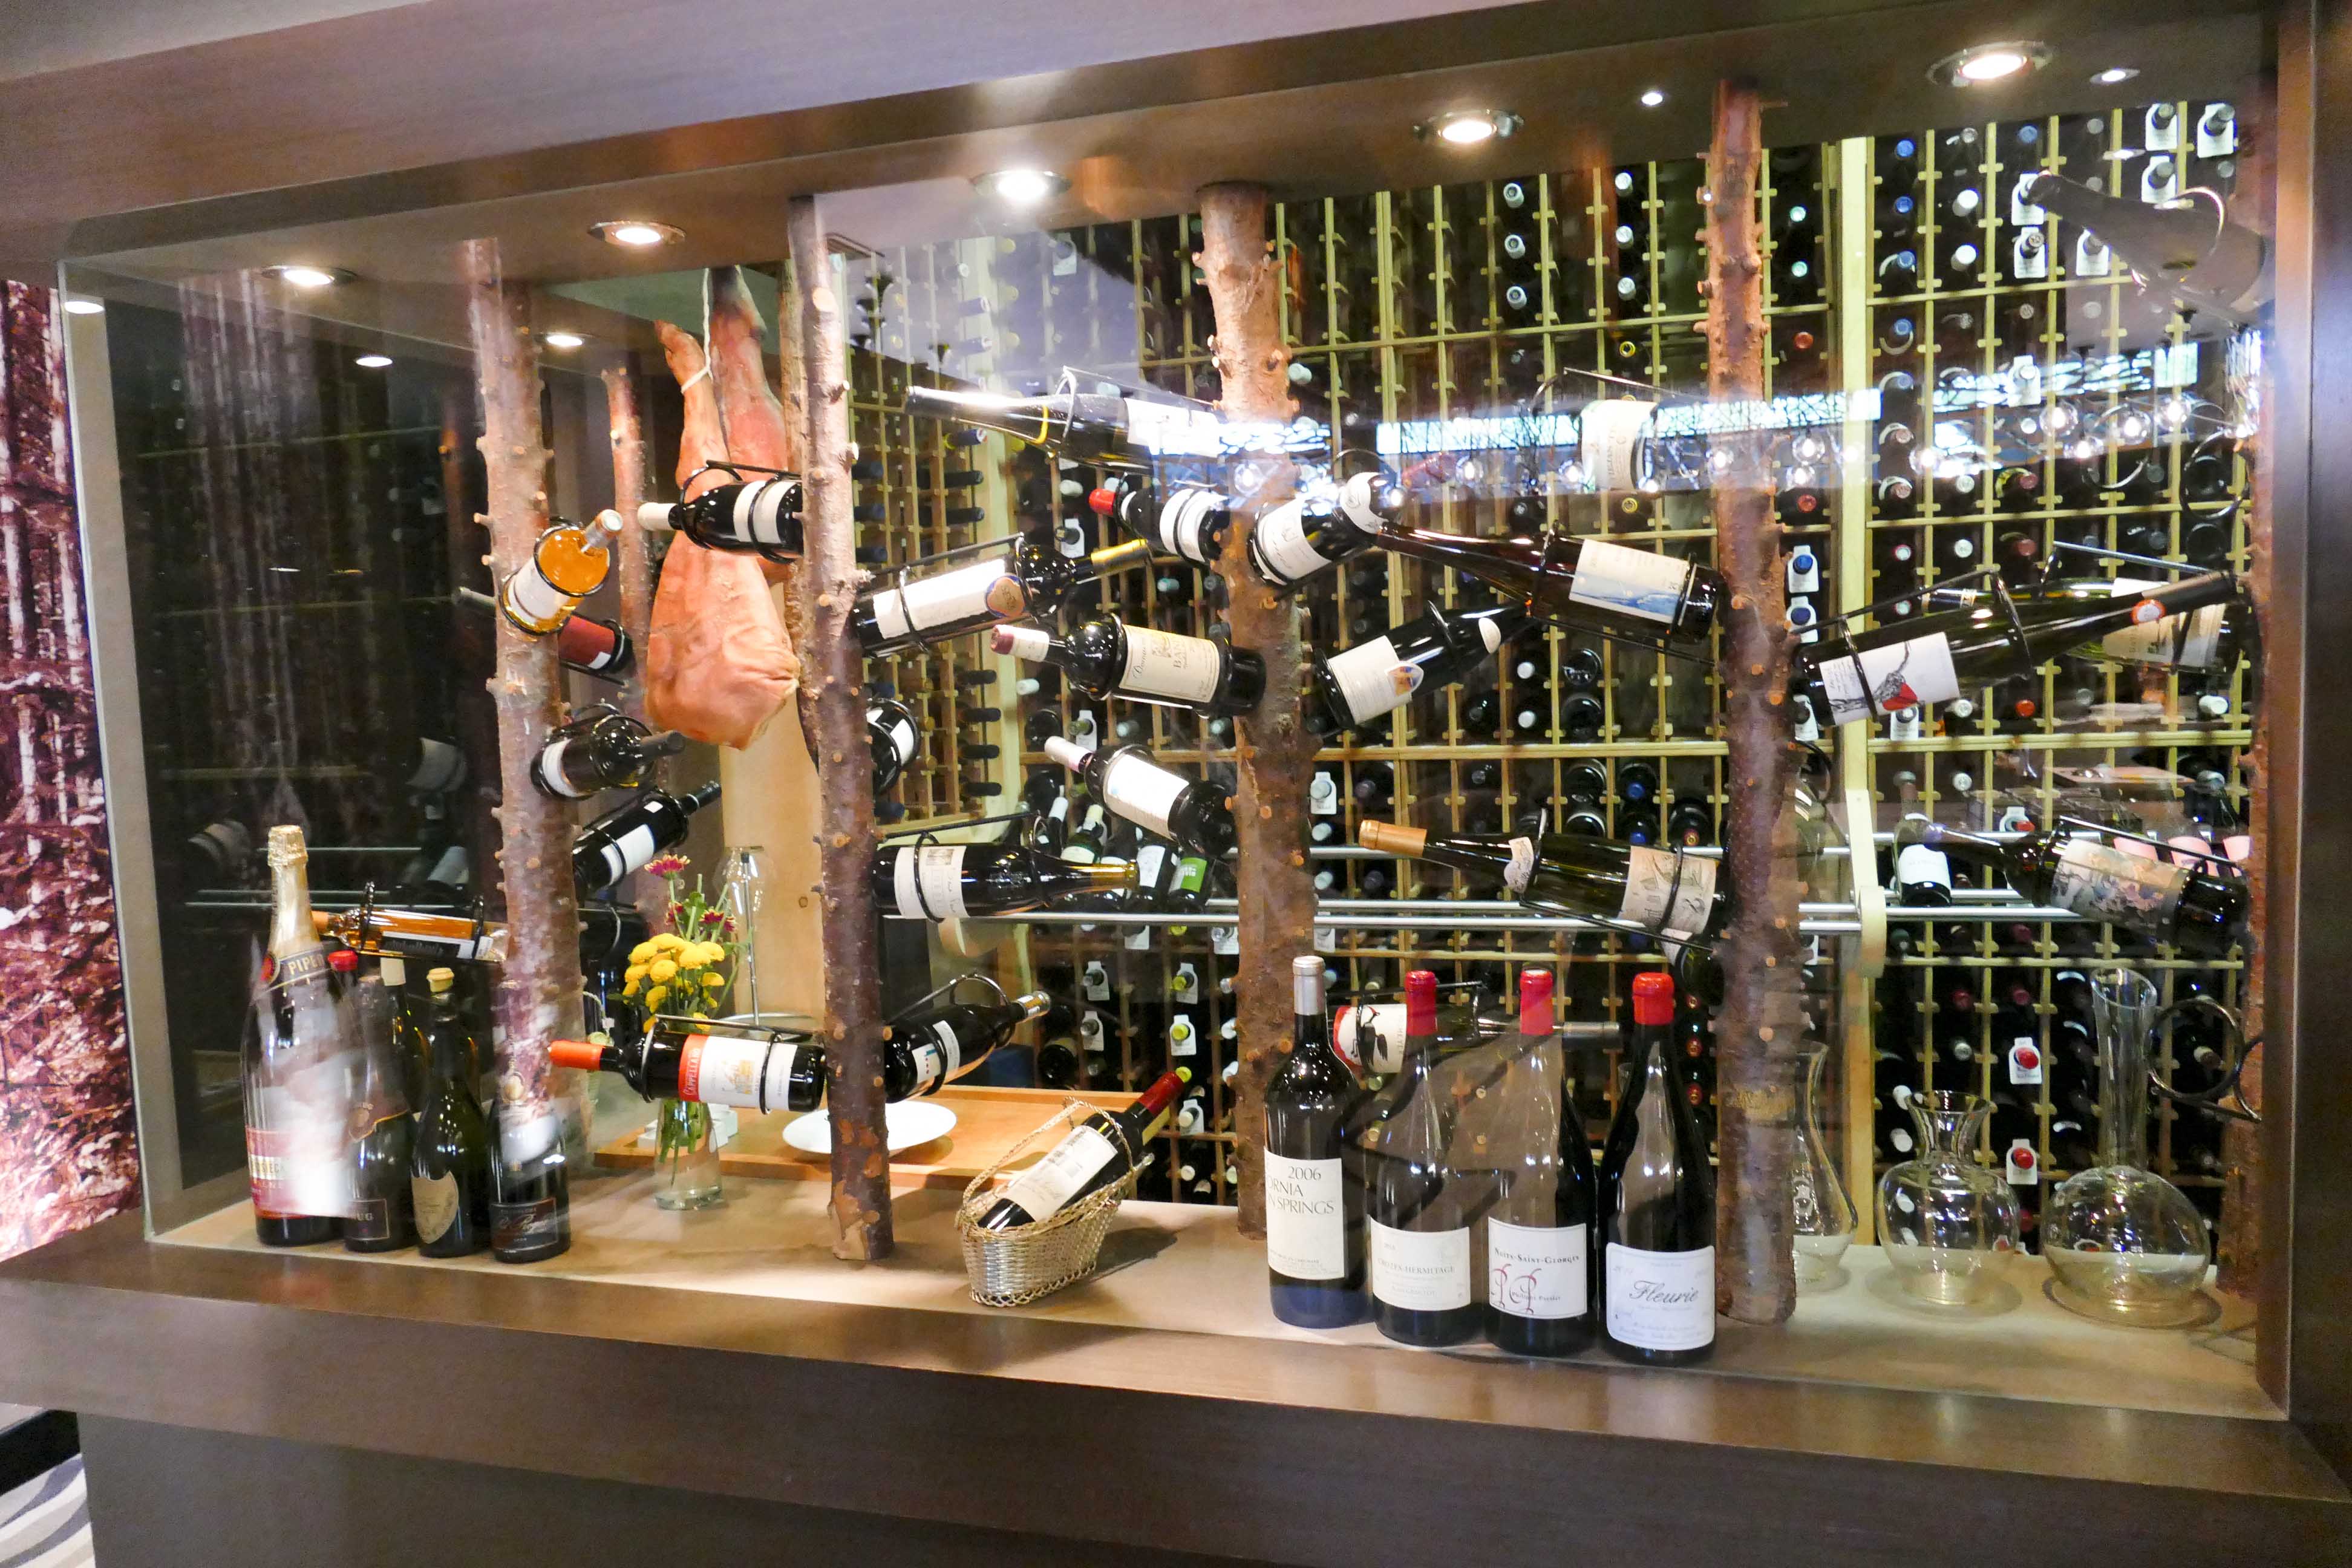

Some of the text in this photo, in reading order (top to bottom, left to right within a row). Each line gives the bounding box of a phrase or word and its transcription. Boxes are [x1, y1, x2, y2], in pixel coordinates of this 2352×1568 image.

[1287, 1166, 1321, 1181] 2006
[1267, 1175, 1304, 1197] ORNIA
[1277, 1195, 1334, 1215] SPRINGS
[1628, 1279, 1699, 1304] Fleurie
